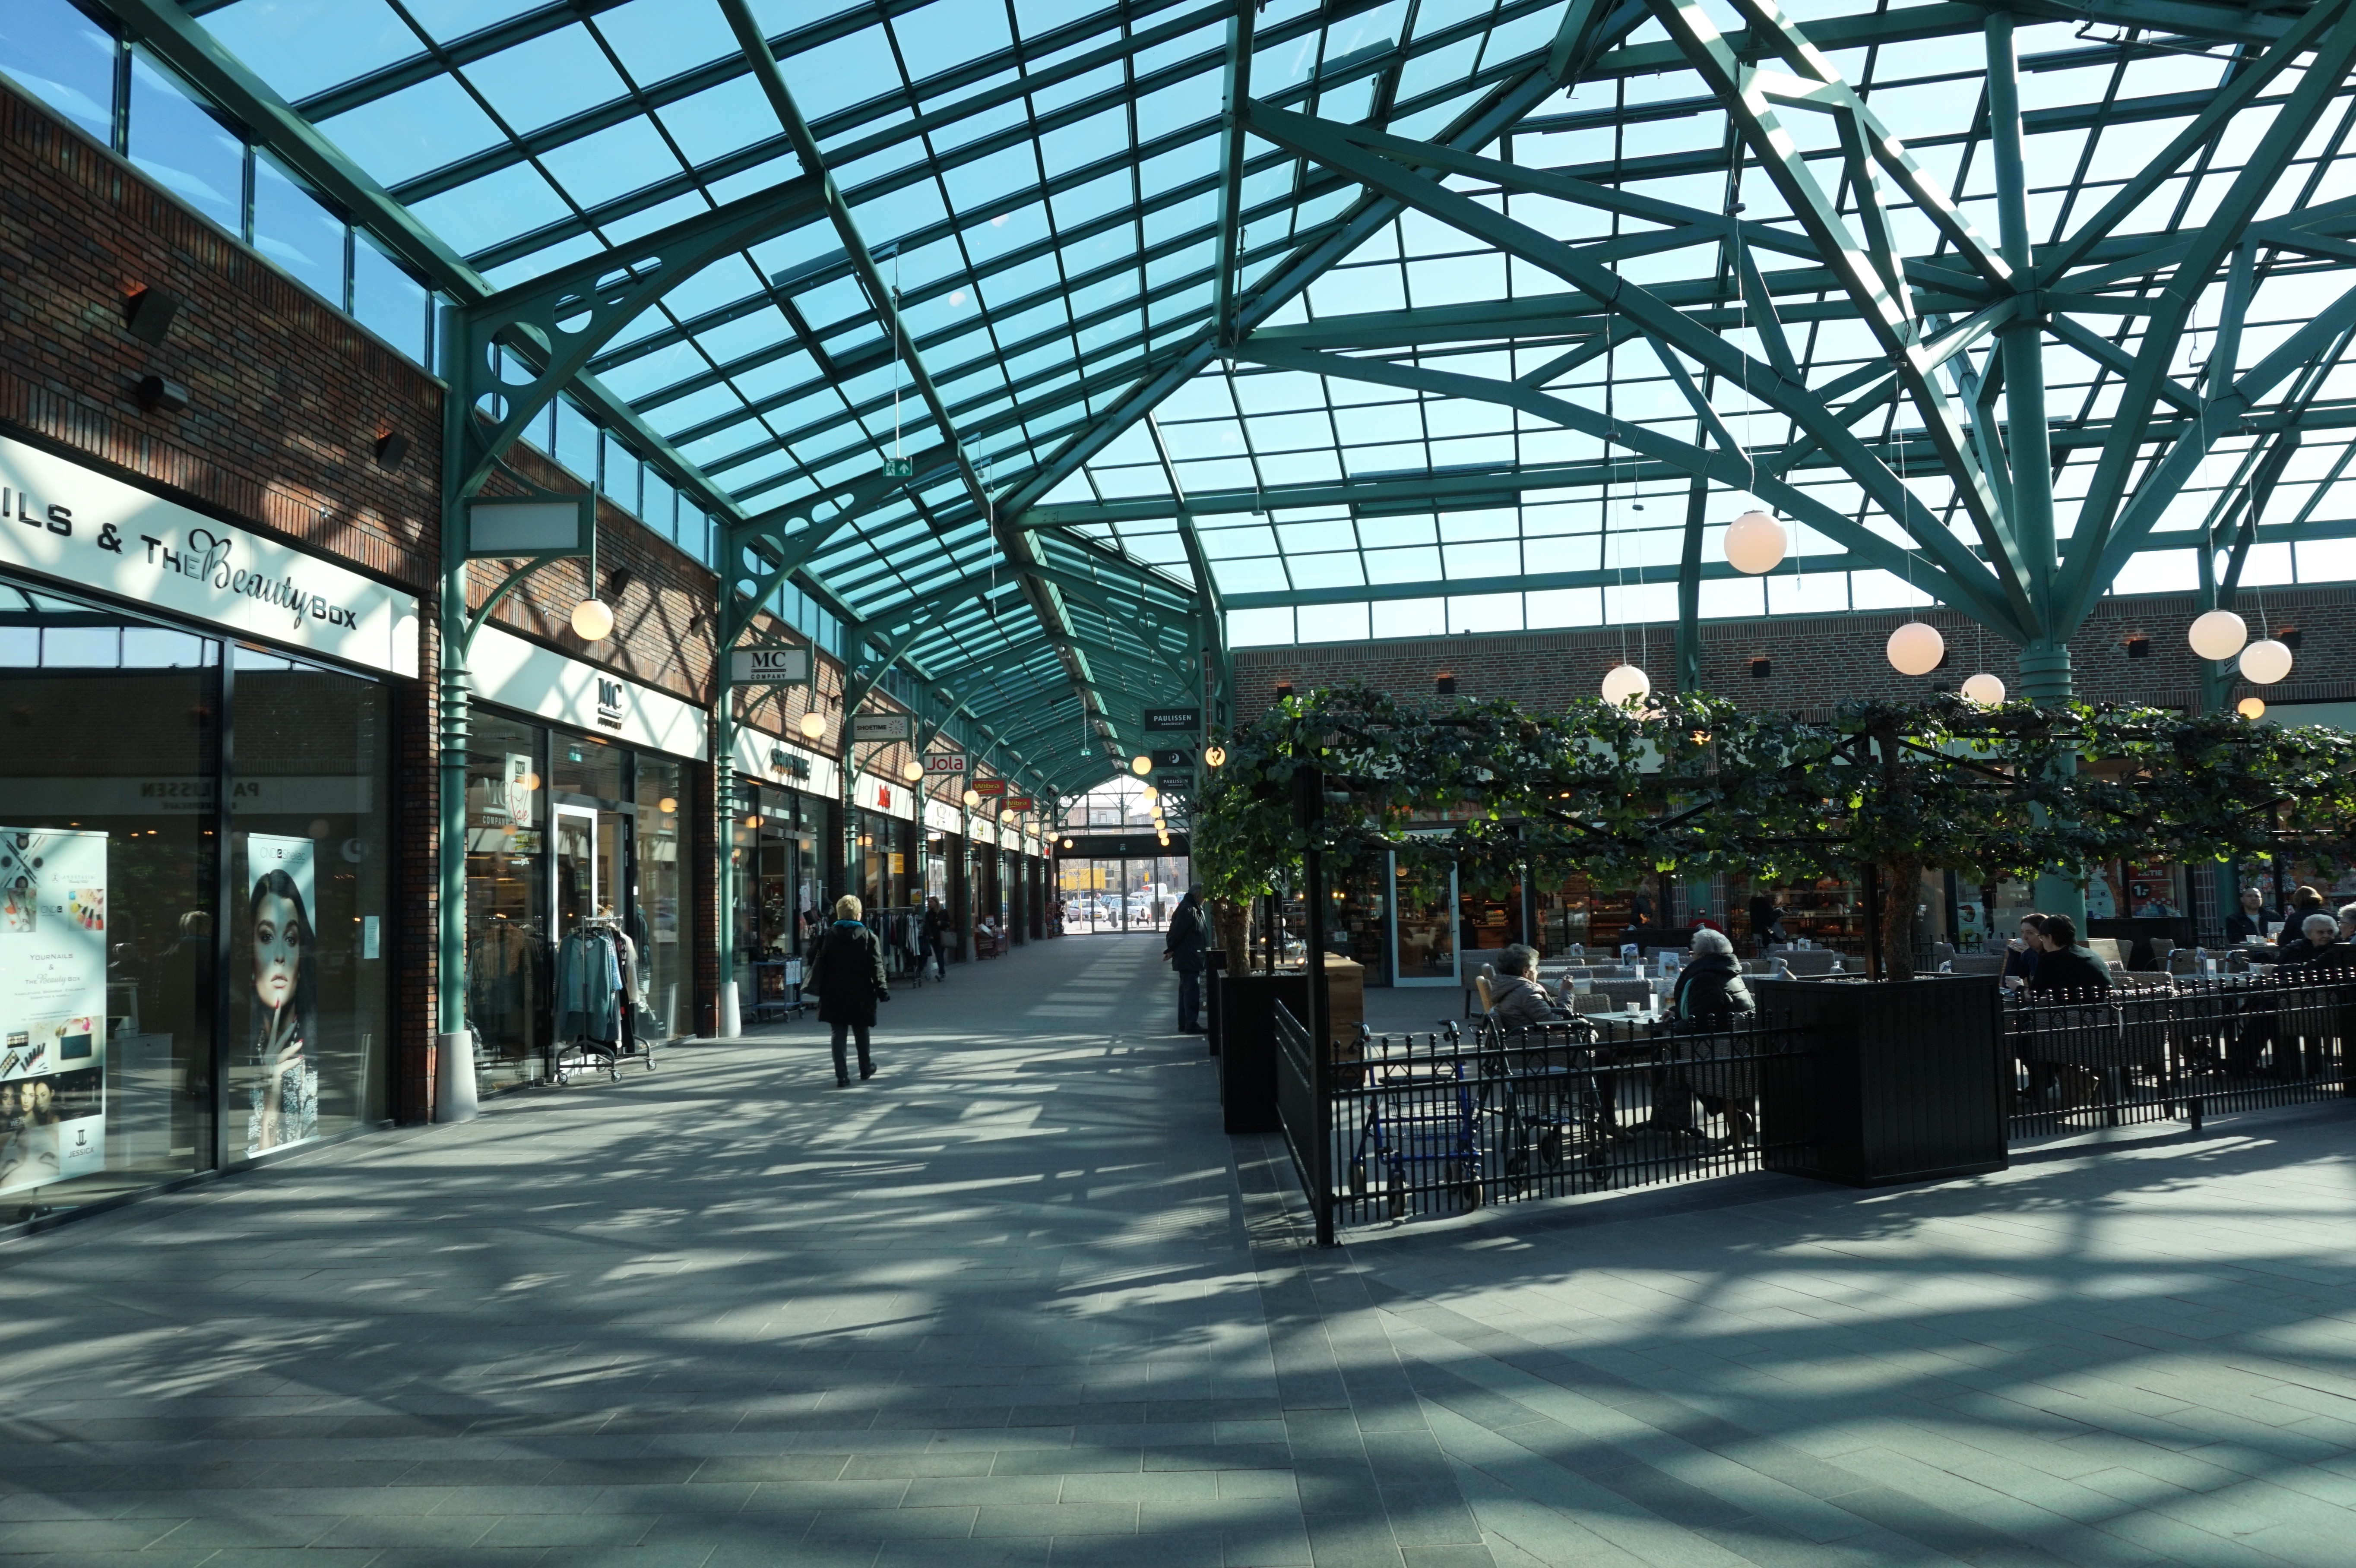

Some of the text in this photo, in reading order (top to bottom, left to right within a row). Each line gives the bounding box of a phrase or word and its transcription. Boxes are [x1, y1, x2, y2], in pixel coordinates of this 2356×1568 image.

[3, 487, 73, 537] ILS
[97, 522, 122, 555] &
[140, 534, 203, 580] THE
[188, 528, 313, 630] Beauty
[751, 651, 786, 668] MC
[597, 677, 622, 710] MC
[516, 763, 525, 774] MC
[927, 756, 963, 771] Jola
[483, 816, 509, 825] COMPAN
[37, 973, 66, 986] Beauty
[68, 1147, 95, 1159] JESSICA
